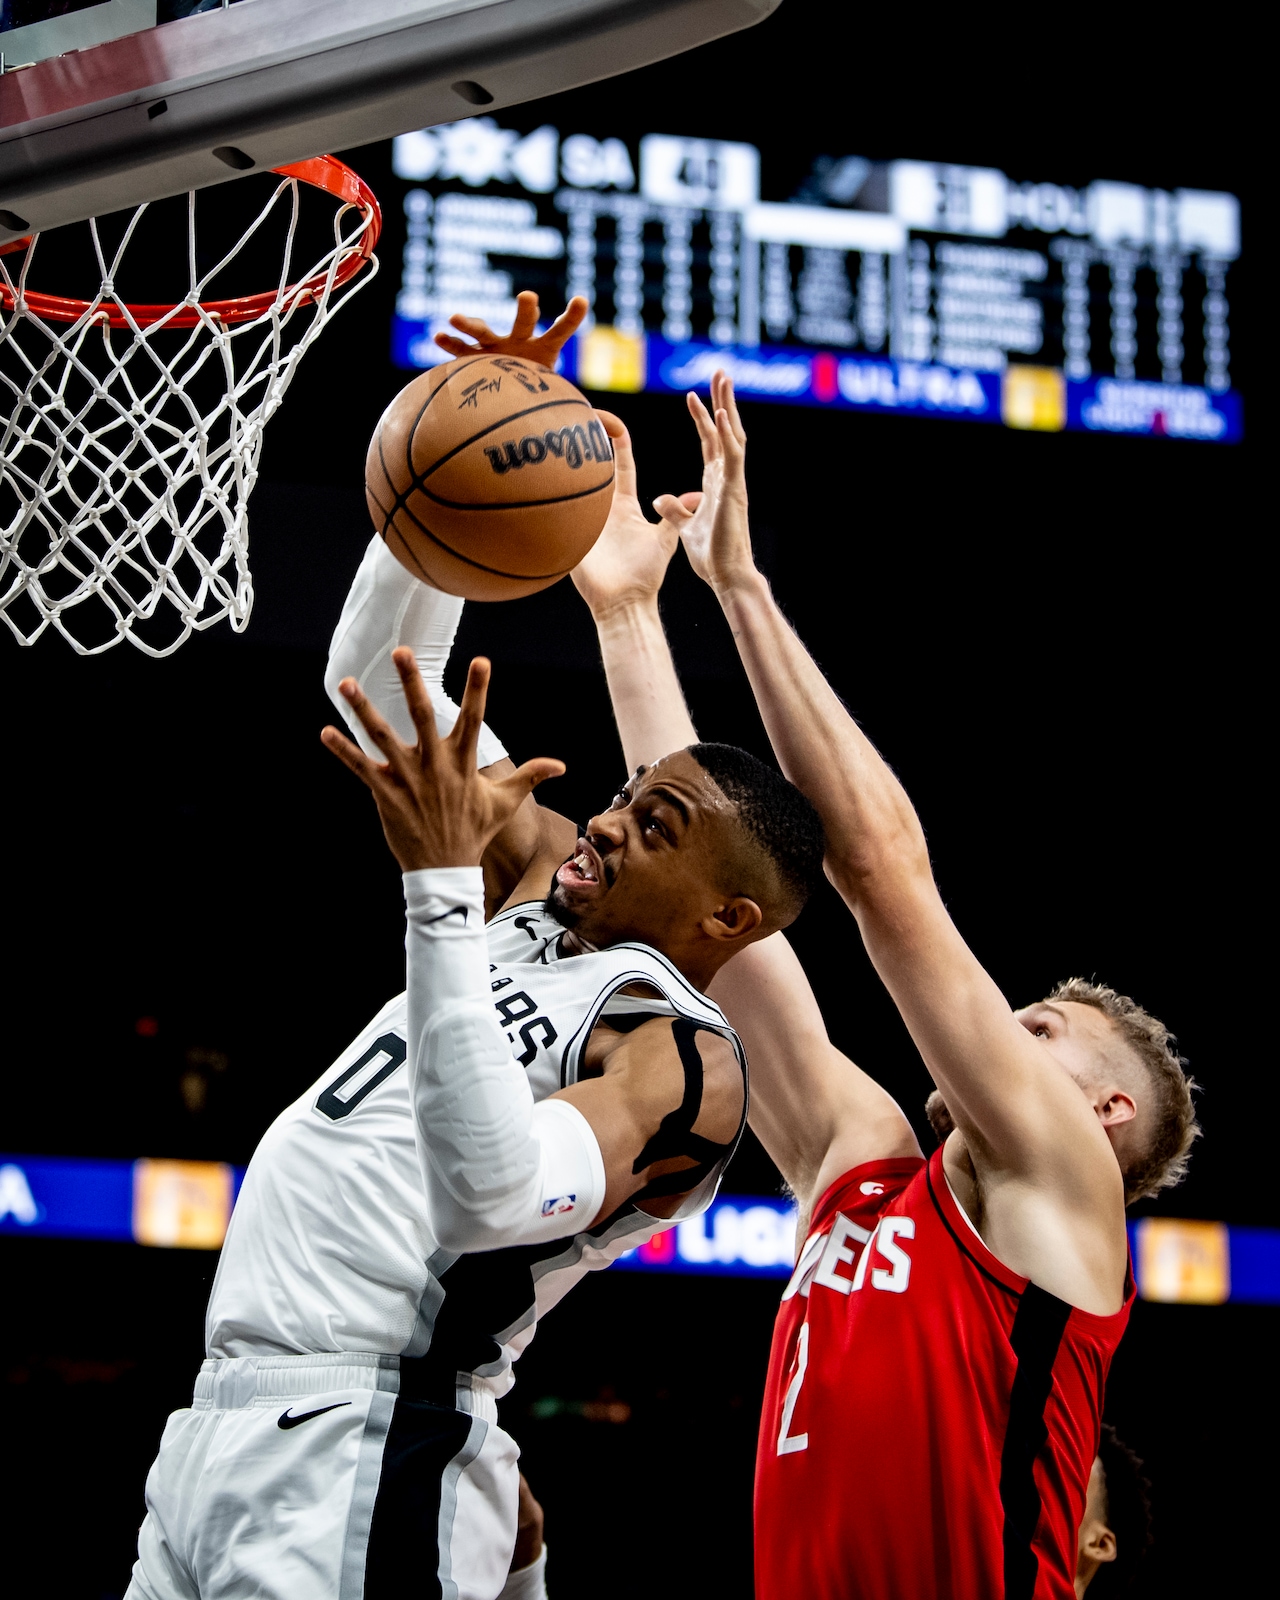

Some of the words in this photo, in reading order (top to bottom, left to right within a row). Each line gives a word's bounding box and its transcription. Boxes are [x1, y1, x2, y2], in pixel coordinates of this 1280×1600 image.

[561, 133, 636, 189] SA
[483, 419, 614, 475] Wilson
[312, 1032, 407, 1124] 0
